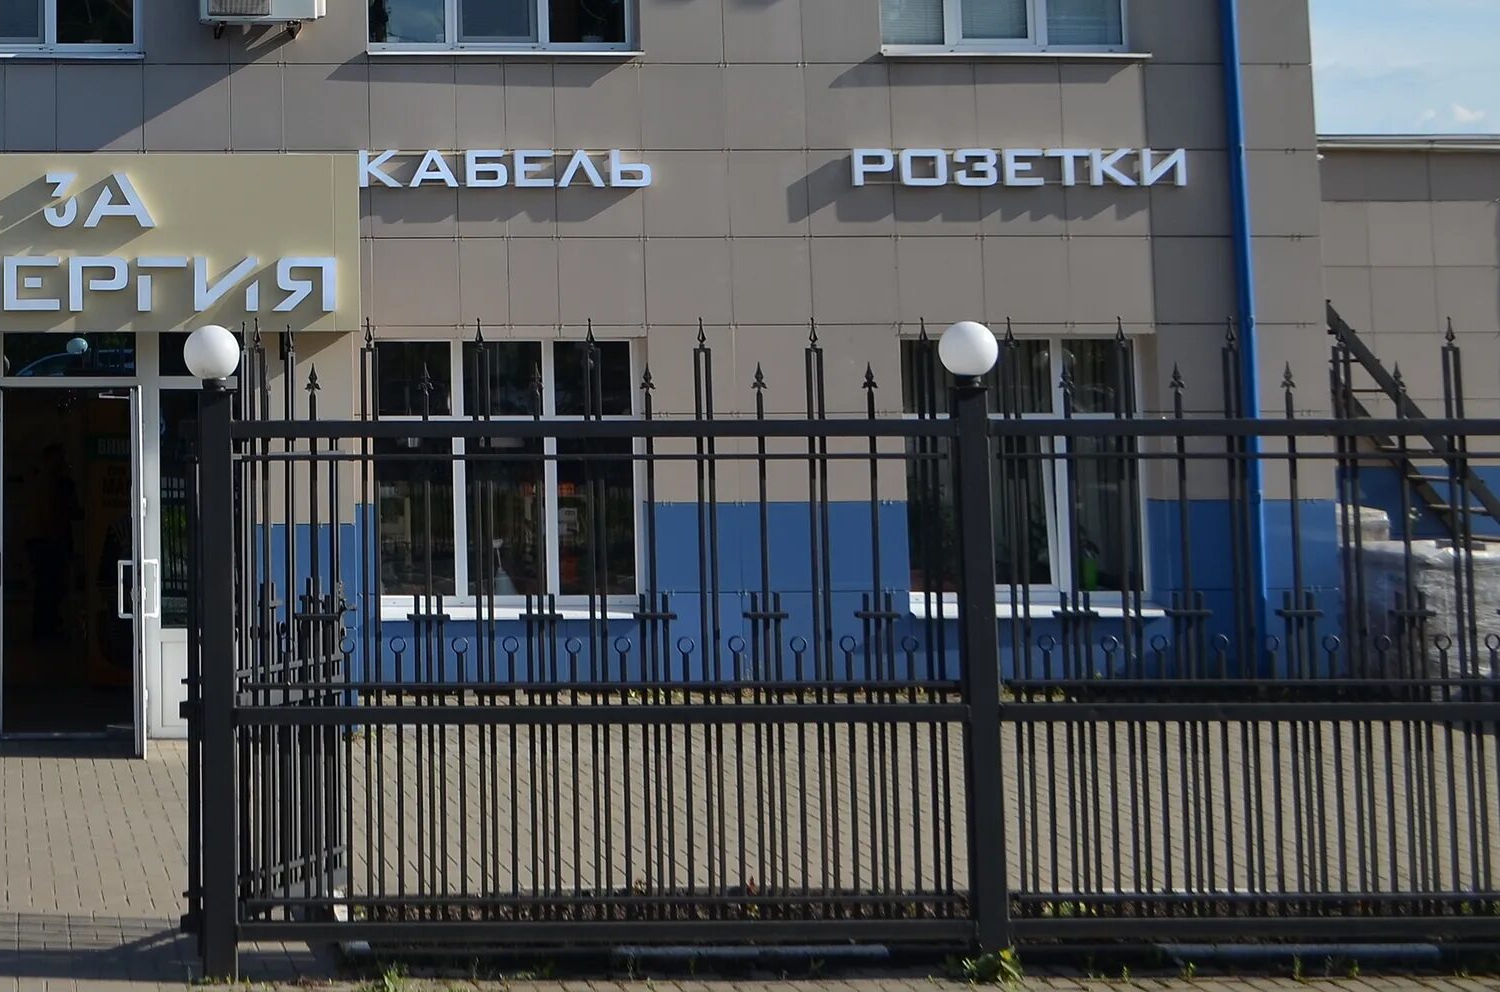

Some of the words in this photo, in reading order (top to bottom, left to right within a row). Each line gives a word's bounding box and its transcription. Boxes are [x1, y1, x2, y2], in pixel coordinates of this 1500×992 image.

[358, 149, 653, 189] КАБЕЛЬ
[851, 148, 1188, 187] РОЗЕТКИ
[42, 171, 157, 229] ЗА
